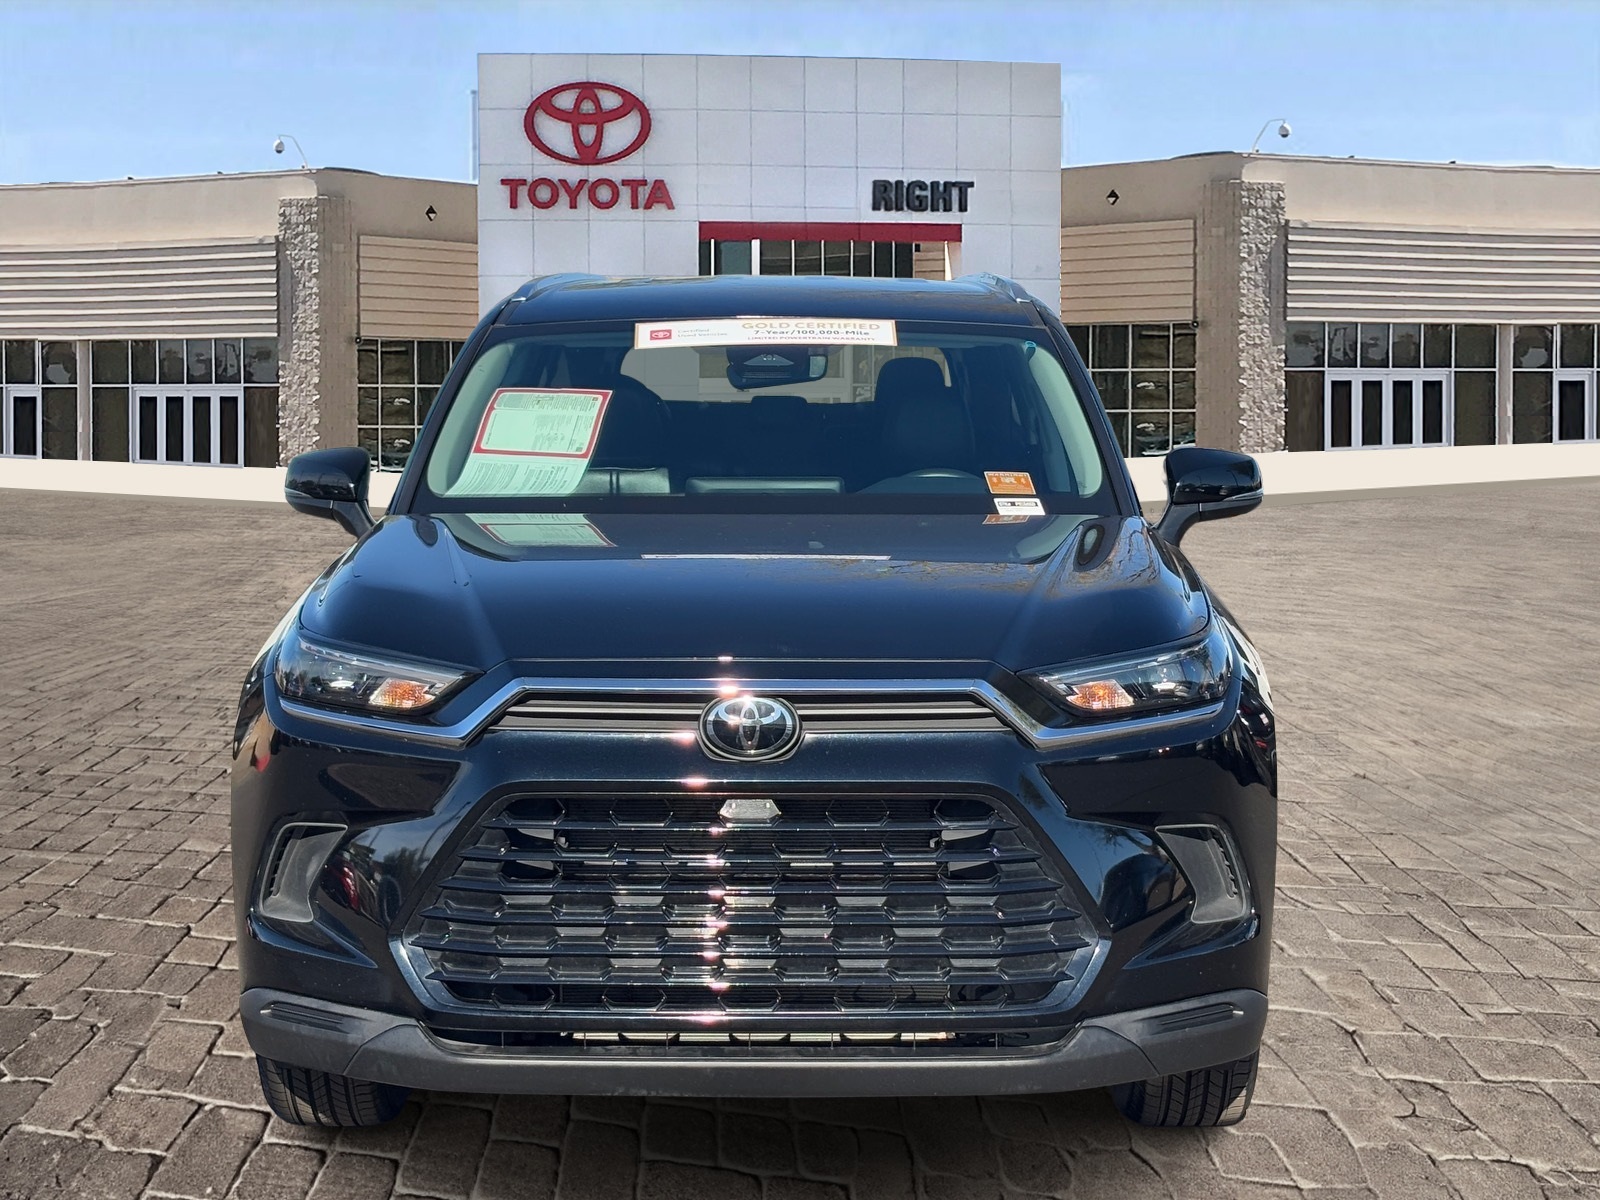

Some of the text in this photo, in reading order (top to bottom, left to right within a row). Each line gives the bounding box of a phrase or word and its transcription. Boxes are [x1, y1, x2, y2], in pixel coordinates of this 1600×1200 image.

[500, 178, 975, 213] TOYOTA RIGHT
[741, 322, 881, 331] GOLD CERTIFIED
